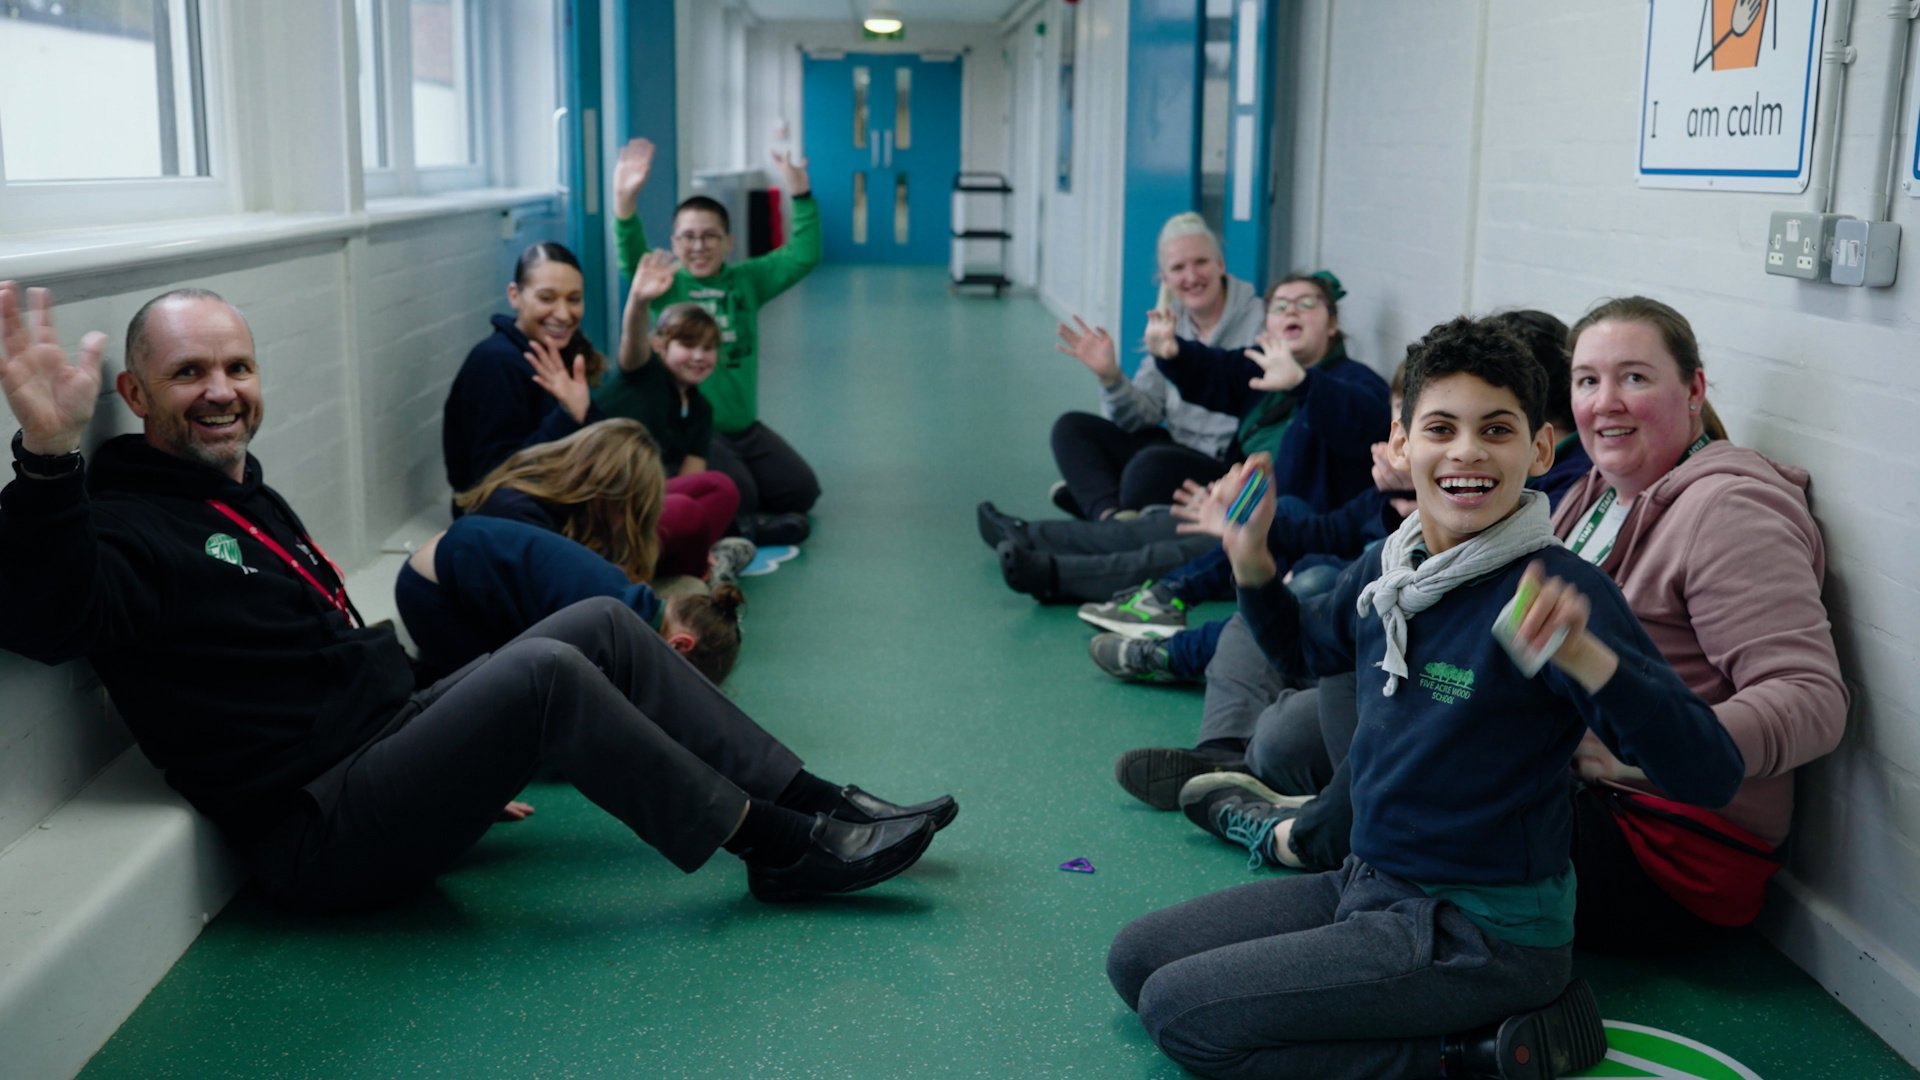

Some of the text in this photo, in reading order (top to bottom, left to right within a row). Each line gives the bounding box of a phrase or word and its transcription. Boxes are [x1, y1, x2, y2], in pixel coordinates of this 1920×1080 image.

[1651, 91, 1782, 138] I am calm
[1579, 491, 1614, 543] STAFF STAFF
[1420, 679, 1435, 690] FIVE
[1451, 687, 1471, 699] WOOD
